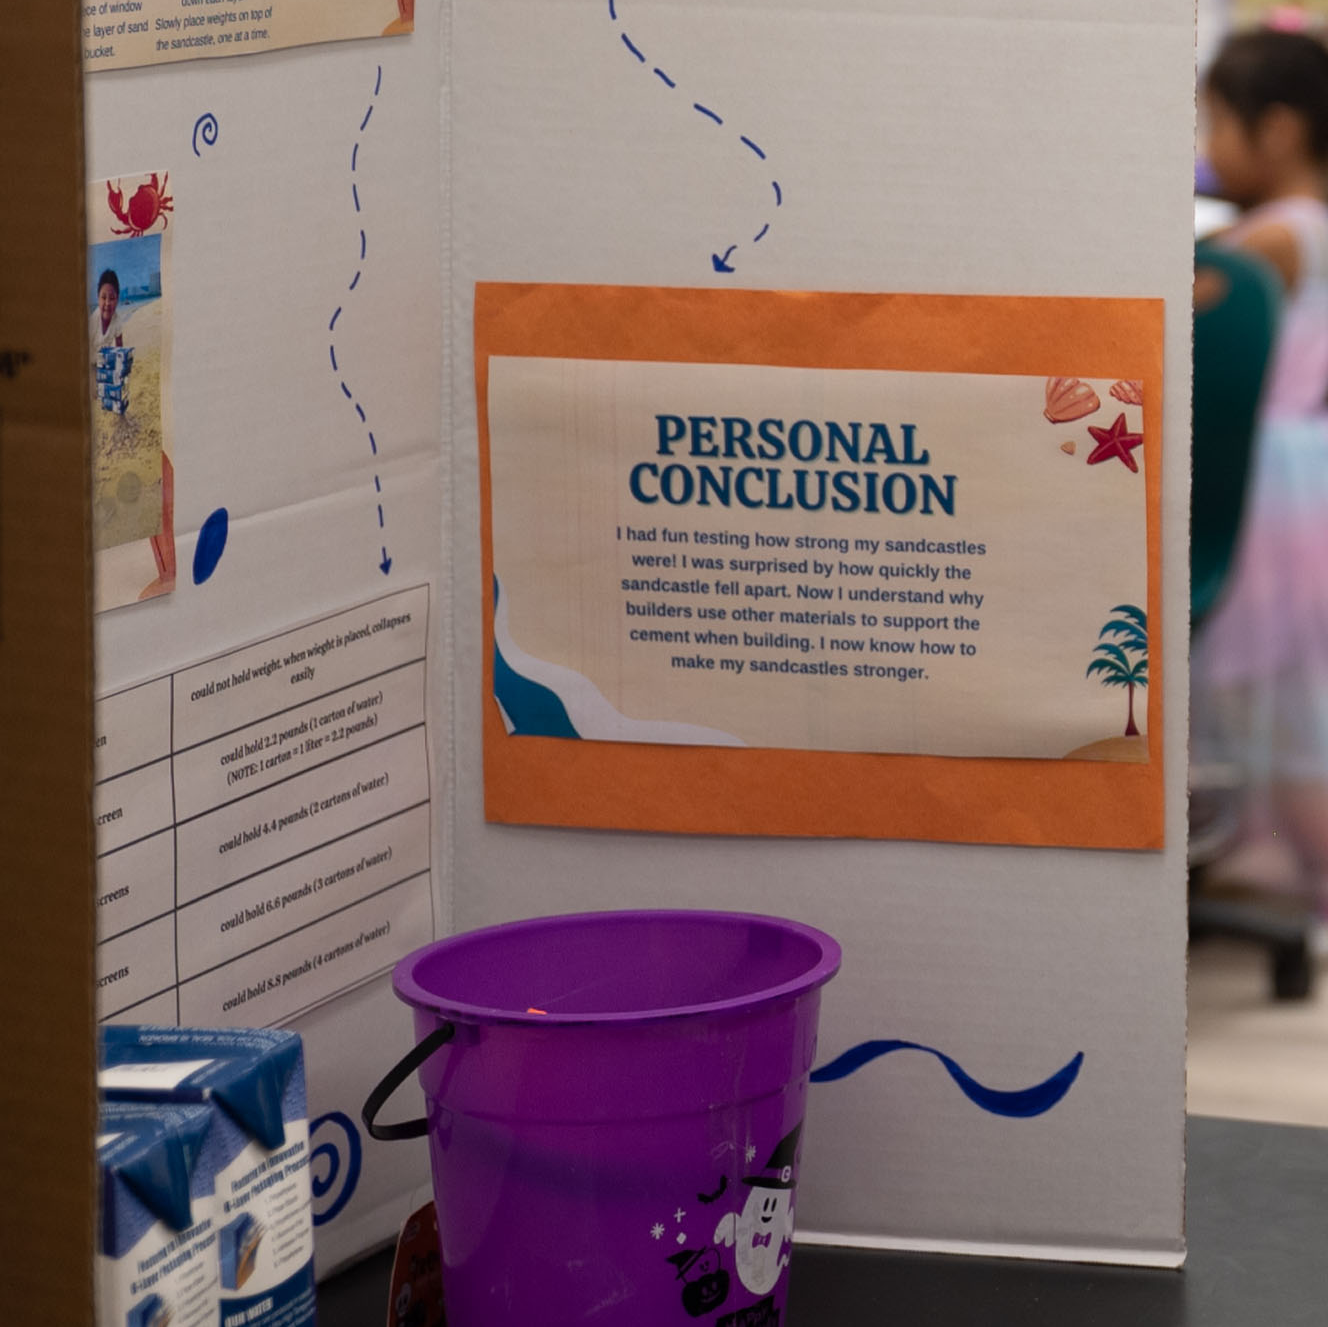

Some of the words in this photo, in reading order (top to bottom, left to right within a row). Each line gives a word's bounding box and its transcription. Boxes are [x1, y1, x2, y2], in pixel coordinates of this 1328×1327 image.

[655, 414, 929, 465] PERSONAL
[630, 462, 957, 516] CONCLUSION
[616, 526, 622, 541] I
[626, 526, 658, 542] had
[660, 527, 690, 543] fun
[692, 530, 751, 550] testing
[754, 531, 791, 548] how
[794, 535, 850, 554] strong
[854, 539, 881, 555] my
[884, 538, 987, 556] sandcastles
[631, 553, 678, 569] were!
[681, 554, 688, 569] I
[690, 557, 725, 571] was
[728, 557, 809, 576] surprised
[812, 559, 835, 579] by
[838, 560, 875, 577] how
[878, 562, 941, 583] quickly
[943, 564, 972, 581] the
[620, 577, 711, 595] sandcastle
[713, 579, 740, 596] fell
[743, 584, 792, 601] apart.
[796, 584, 835, 600] Now
[837, 586, 843, 601] I
[847, 587, 945, 605] understand
[948, 590, 985, 610] why
[625, 600, 693, 619] builders
[697, 607, 727, 621] use
[731, 606, 775, 623] other
[780, 610, 857, 627] materials
[861, 613, 878, 627] to
[883, 615, 949, 633] support
[953, 615, 980, 631] the
[629, 629, 691, 644] cement
[693, 629, 739, 646] when
[742, 631, 816, 654] building.
[819, 635, 826, 651] I
[829, 638, 866, 652] now
[869, 637, 916, 654] know
[919, 639, 956, 656] how
[959, 642, 977, 657] to
[290, 665, 316, 685] easily
[671, 654, 715, 670] make
[720, 658, 745, 675] my
[749, 658, 849, 677] sandcastles
[853, 663, 929, 683] stronger.
